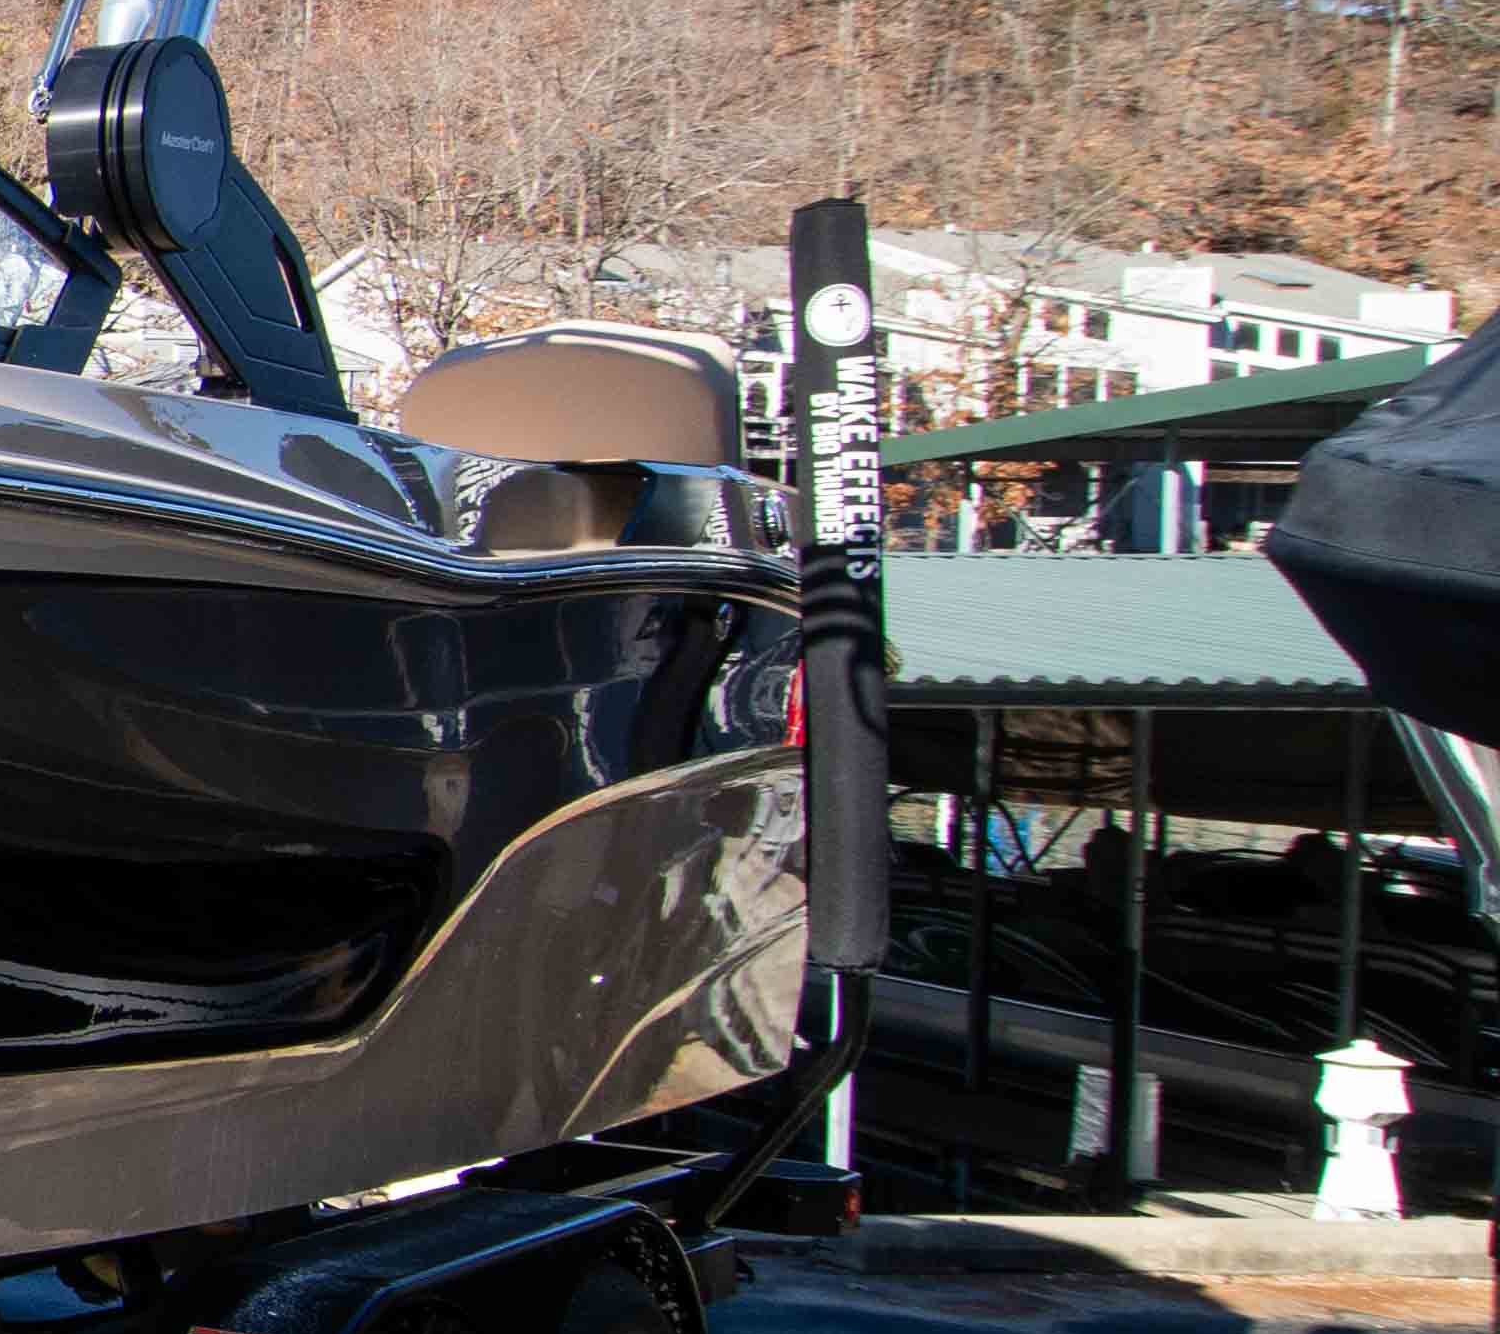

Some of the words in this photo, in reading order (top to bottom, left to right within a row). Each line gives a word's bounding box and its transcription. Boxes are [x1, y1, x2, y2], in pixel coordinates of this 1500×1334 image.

[810, 393, 841, 418] BY
[812, 422, 842, 455] BIG
[837, 356, 877, 443] WAKE
[815, 460, 845, 545] THUNDER
[844, 452, 882, 579] EFFECTS
